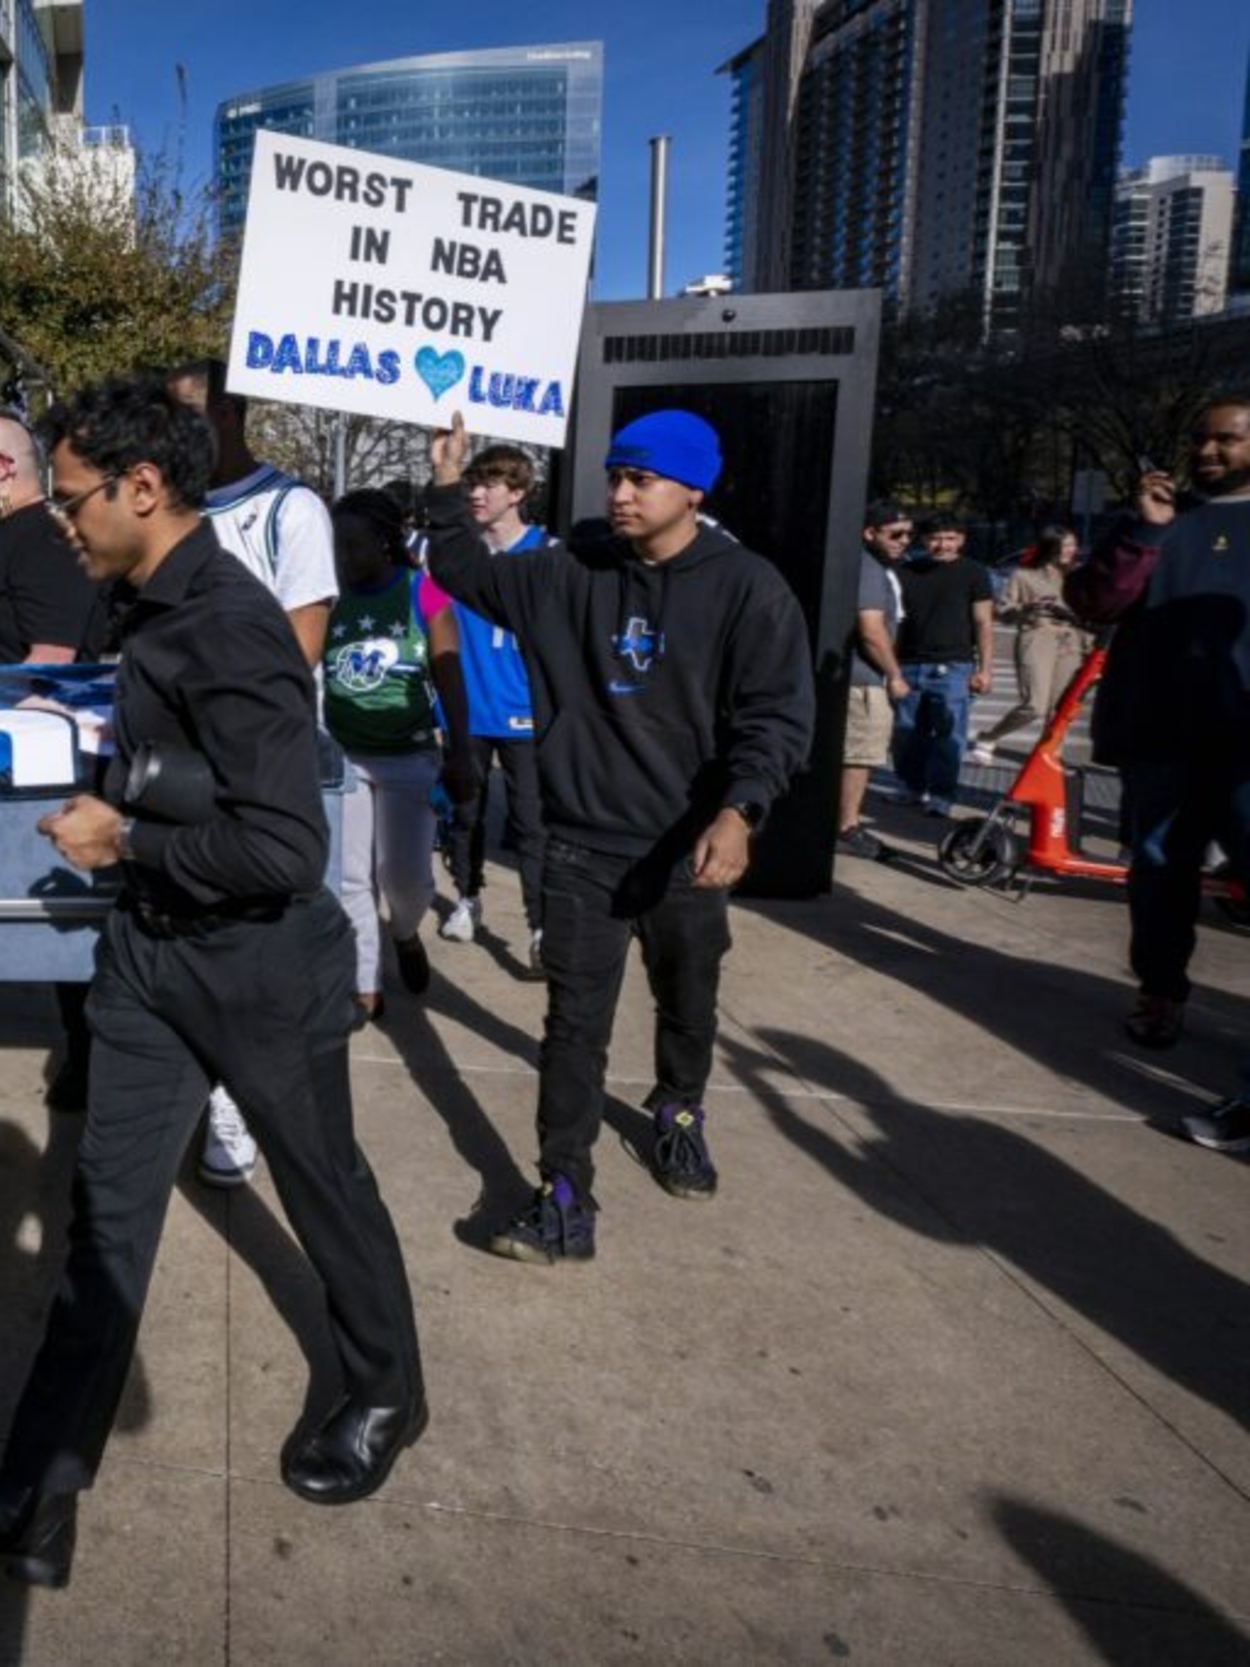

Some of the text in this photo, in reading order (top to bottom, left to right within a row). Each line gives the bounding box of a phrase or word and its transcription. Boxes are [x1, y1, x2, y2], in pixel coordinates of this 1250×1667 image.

[273, 153, 578, 245] WORST TRADE
[350, 226, 507, 284] IN NBA
[332, 279, 503, 342] HISTORY
[246, 331, 565, 417] DALLAS LUKA
